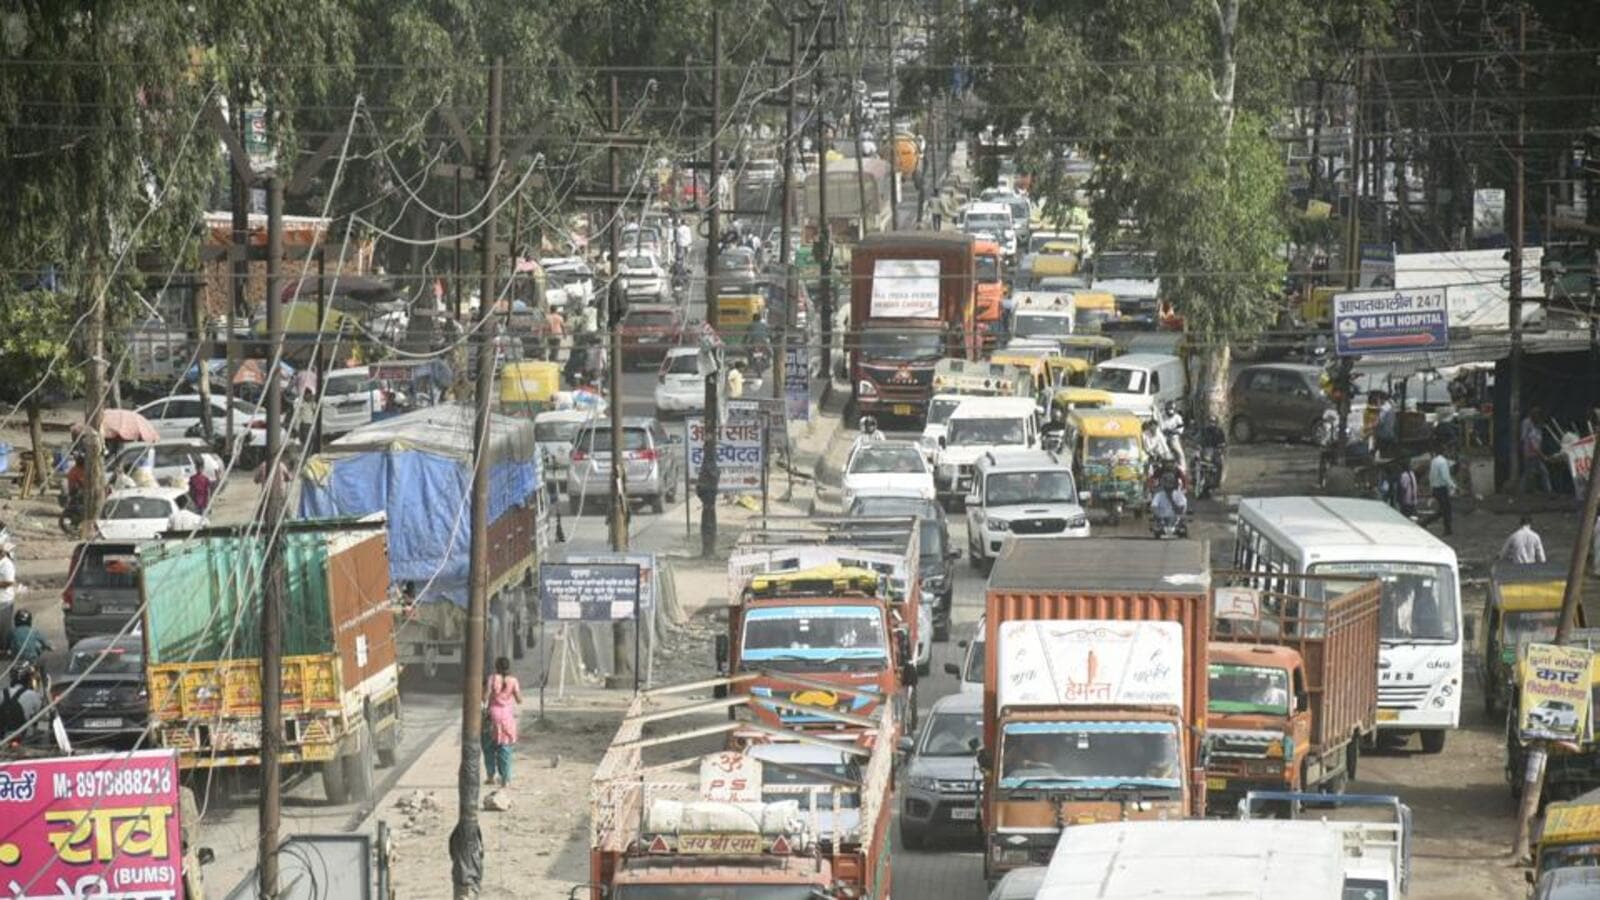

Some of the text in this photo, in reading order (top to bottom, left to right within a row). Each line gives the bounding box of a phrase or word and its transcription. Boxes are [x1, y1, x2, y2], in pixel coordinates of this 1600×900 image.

[1338, 292, 1413, 313] आपातकालीन
[1360, 312, 1442, 328] OM SAI HOSPITAL
[1536, 667, 1580, 684] कार
[53, 773, 73, 798] M:
[683, 835, 706, 850] जय
[730, 835, 757, 850] राम
[113, 865, 176, 889] (BUMS)
